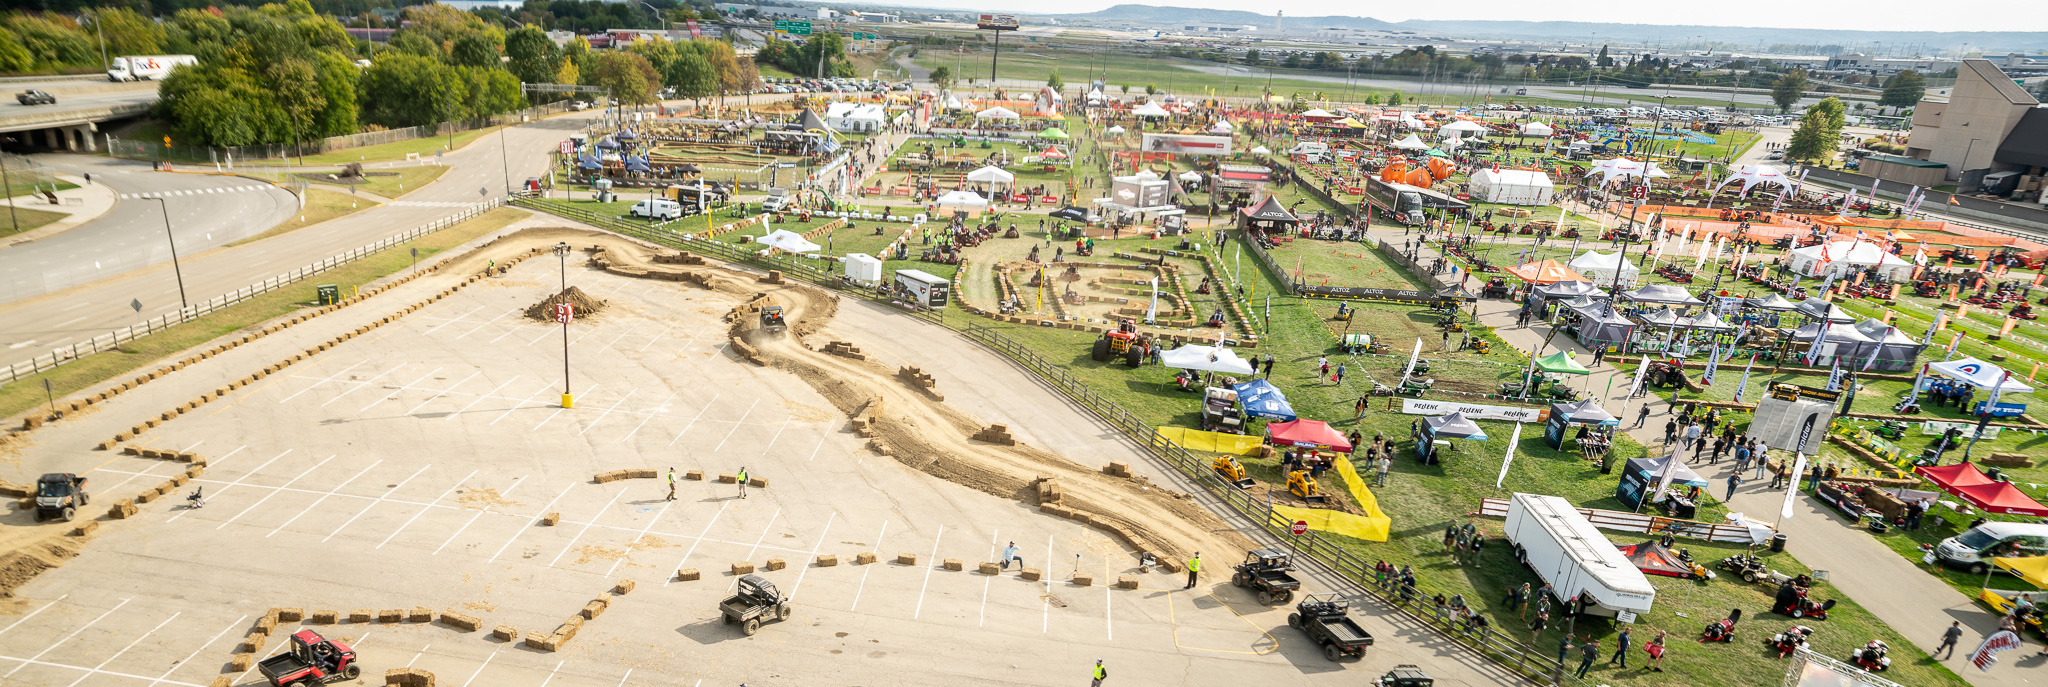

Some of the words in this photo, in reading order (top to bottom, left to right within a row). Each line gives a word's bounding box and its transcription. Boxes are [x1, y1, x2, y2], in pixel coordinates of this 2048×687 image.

[561, 141, 574, 154] EXIT
[558, 305, 565, 314] D
[557, 314, 567, 323] 21
[1707, 363, 1715, 380] TUFF
[1798, 421, 1812, 451] spider
